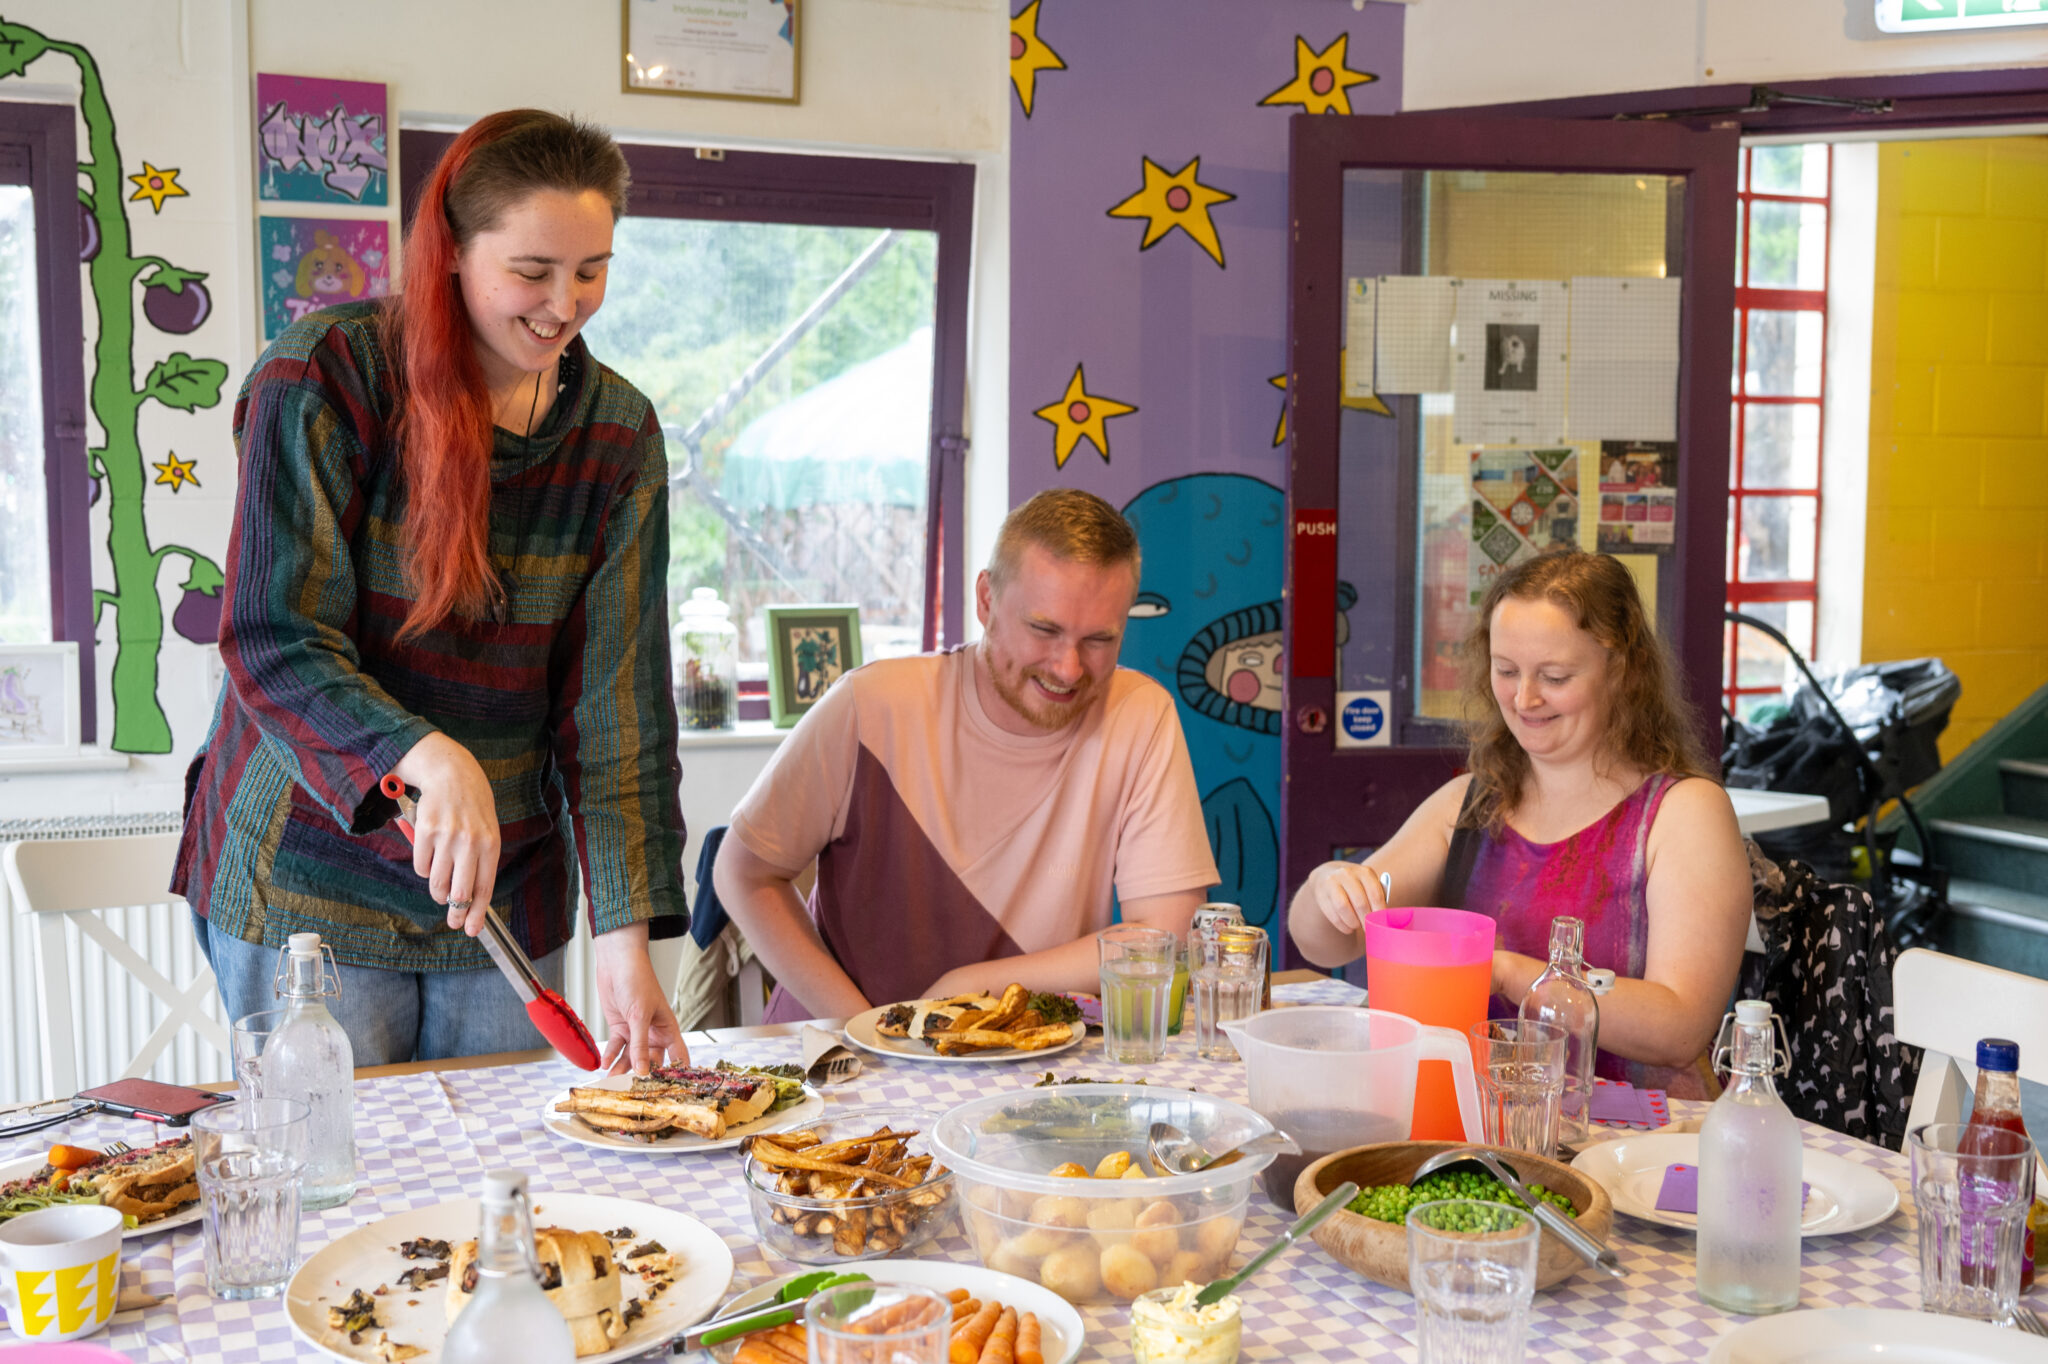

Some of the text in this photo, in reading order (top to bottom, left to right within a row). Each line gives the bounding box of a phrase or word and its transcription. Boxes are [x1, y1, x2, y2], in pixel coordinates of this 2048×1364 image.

[1488, 289, 1538, 302] MISSING
[1297, 521, 1337, 536] PUSH
[1353, 716, 1372, 724] keep
[1350, 724, 1376, 732] closed
